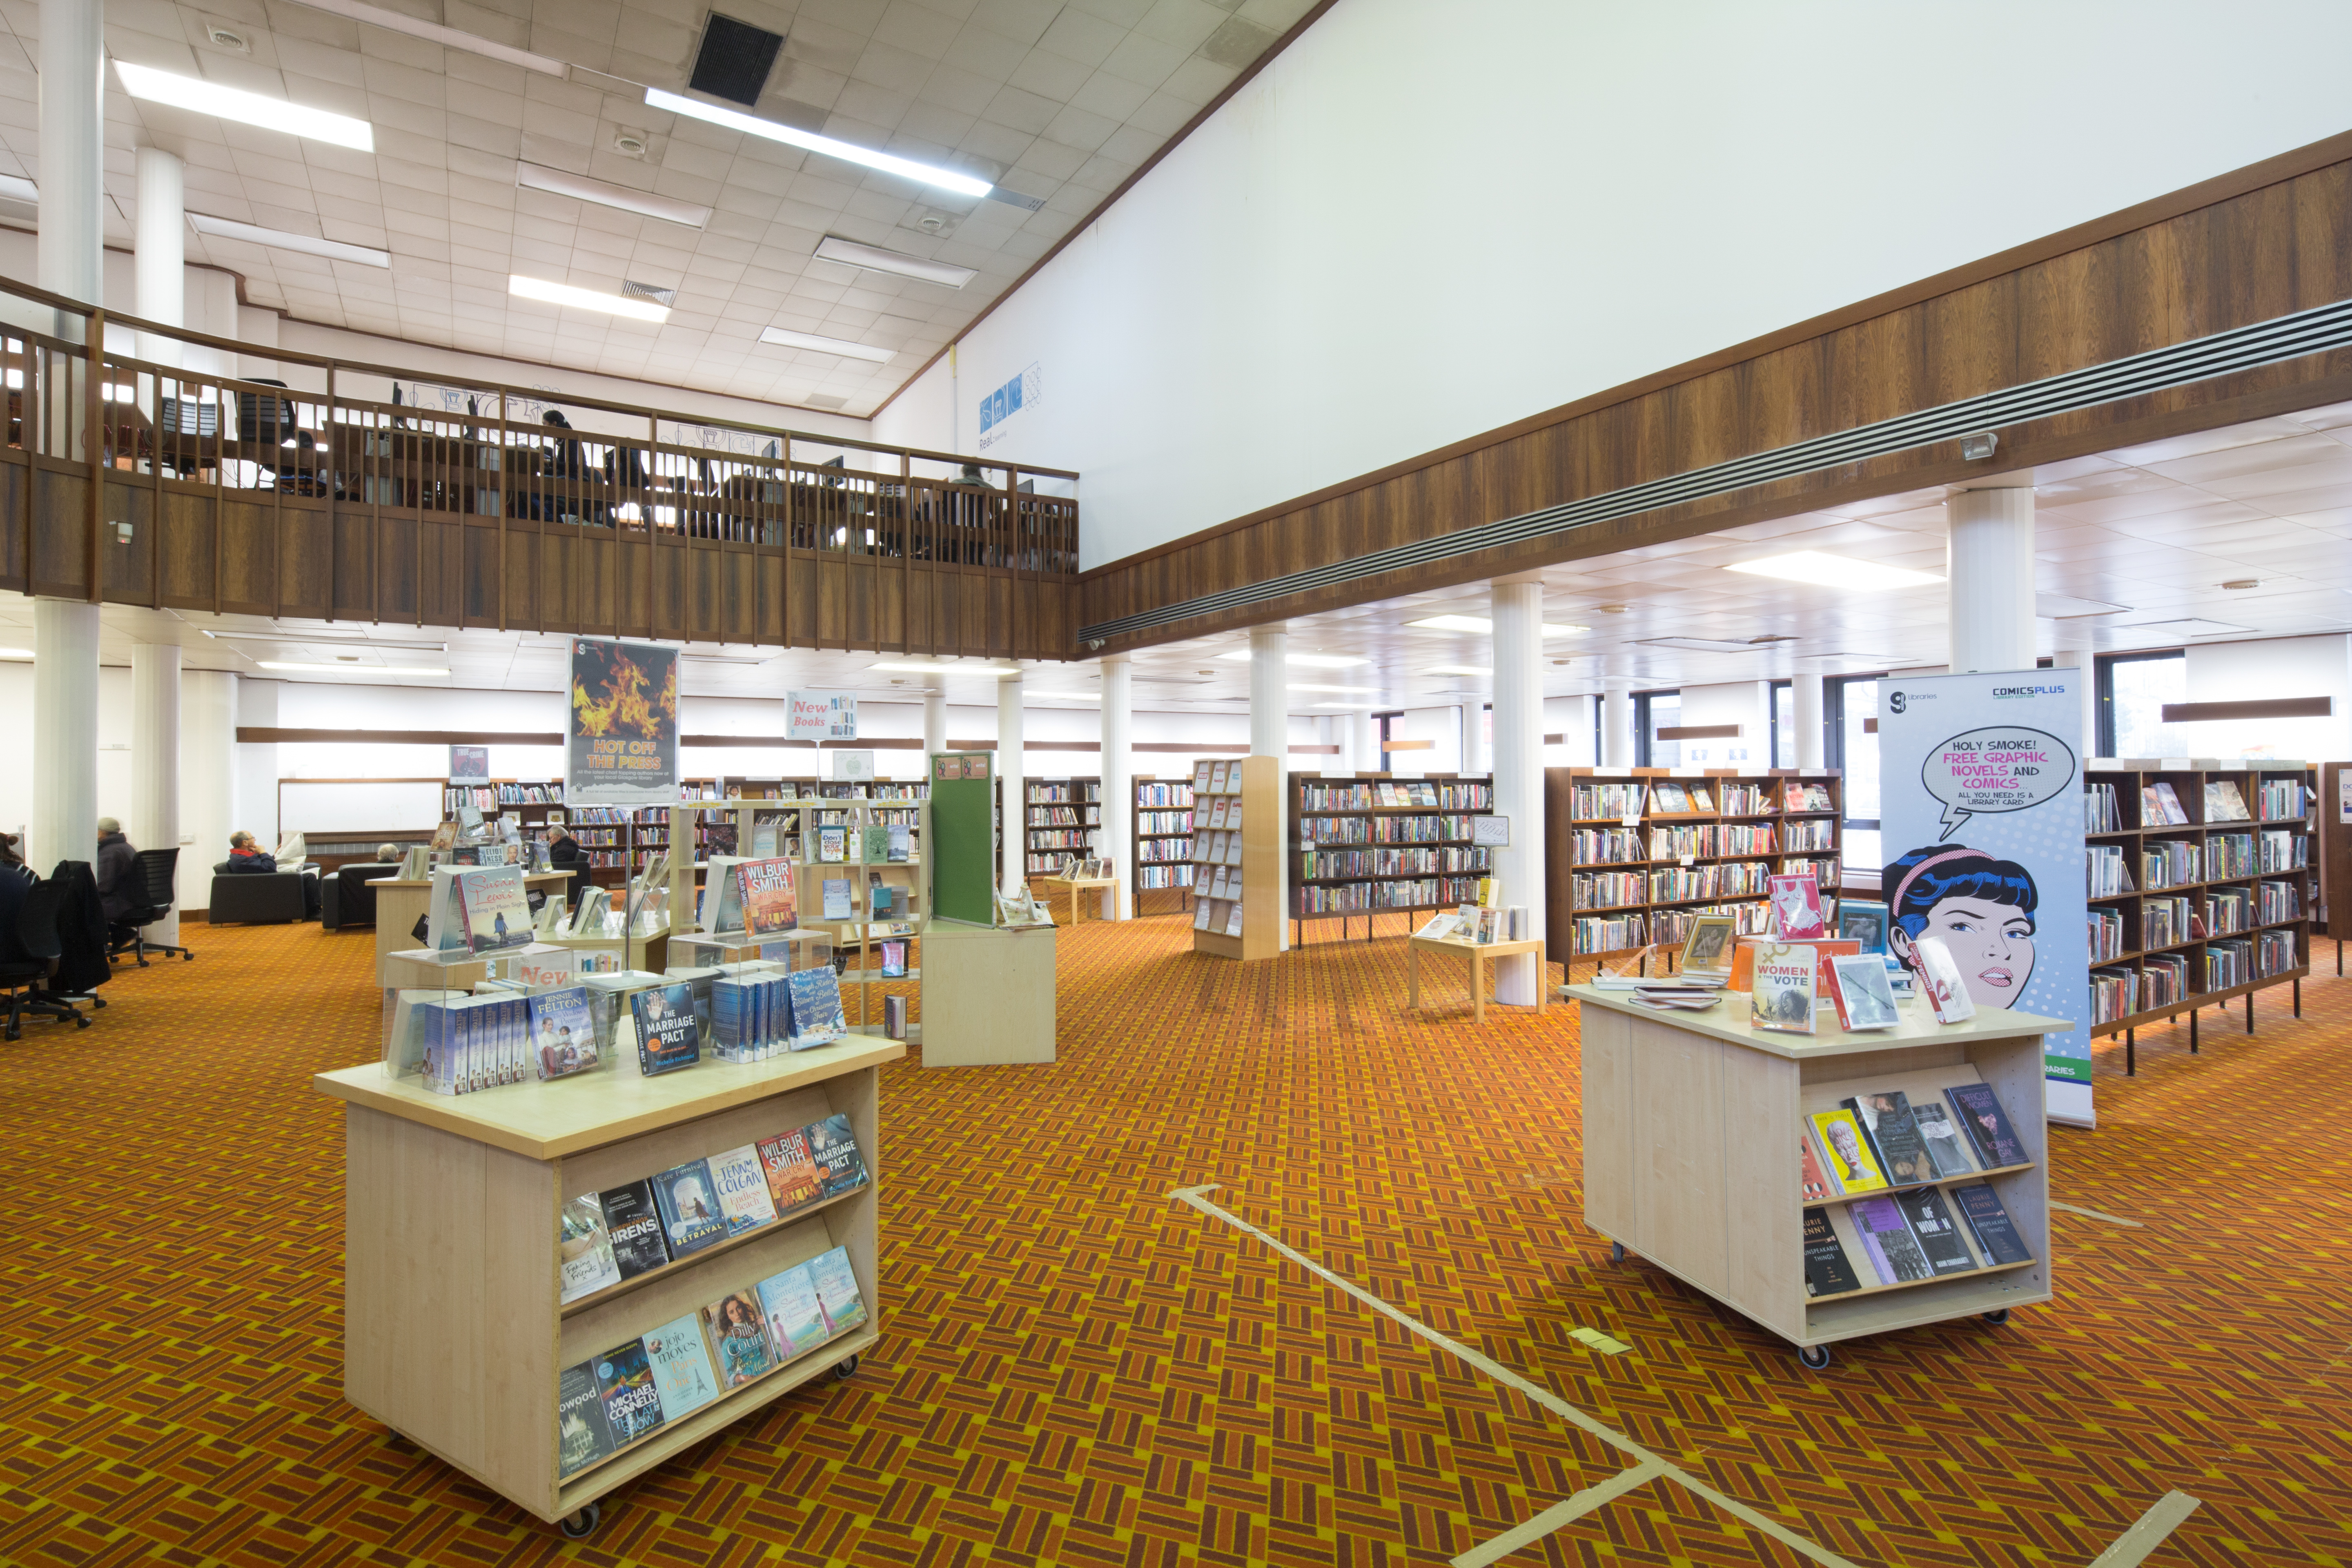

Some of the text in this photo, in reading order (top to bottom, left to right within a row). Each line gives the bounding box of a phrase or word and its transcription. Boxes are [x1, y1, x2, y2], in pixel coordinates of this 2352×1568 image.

[1993, 685, 2065, 695] COMICSPLUS
[793, 701, 828, 713] New
[793, 716, 825, 726] Books
[457, 748, 484, 759] TRUE CRIME
[594, 739, 656, 755] HOT OFF
[1953, 740, 2036, 751] HOLY SMOKE!
[587, 755, 662, 770] THE PRESS
[1943, 752, 2049, 764] FREE GRAPHIC
[1951, 765, 2040, 776] NOVELS AND
[746, 862, 789, 880] WILBUR
[468, 875, 517, 892] Susan
[737, 871, 748, 908] WILBUR SMITH
[752, 876, 788, 893] SMITH
[475, 889, 515, 906] Lewis
[527, 891, 543, 903] CRIME
[774, 891, 786, 899] CRY
[1757, 965, 1809, 976] WOMEN
[1917, 965, 1935, 992] FEMINIST
[795, 978, 834, 995] Sleigh Rides
[1774, 976, 1808, 986] VOTE
[537, 997, 582, 1014] FELTON
[545, 991, 572, 1004] JENNIE
[796, 989, 834, 1007] Silver Bells
[562, 1008, 587, 1018] Widow's
[664, 1009, 676, 1018] THE
[809, 1000, 836, 1013] Christmas
[559, 1015, 584, 1025] Promise
[647, 1015, 695, 1034] MARRIAGE
[813, 1011, 828, 1022] Fair
[661, 1029, 684, 1045] PACT
[675, 1053, 694, 1062] Richmond
[1960, 1091, 1991, 1103] DIFFICULT
[1966, 1100, 1993, 1109] WOMEN
[761, 1134, 804, 1159] WILBUR
[826, 1138, 838, 1147] THE
[1986, 1138, 2016, 1150] ROXANE
[814, 1140, 856, 1164] MARRIAGE
[1998, 1148, 2013, 1158] GAY
[769, 1148, 806, 1173] SMITH
[828, 1154, 849, 1172] PACT
[657, 1160, 706, 1183] Kate Furnivall
[719, 1158, 753, 1181] JENNY
[776, 1163, 805, 1180] WAR CRY
[718, 1169, 761, 1195] COLGAN
[730, 1189, 761, 1205] Endless
[735, 1198, 760, 1212] Beach
[1968, 1194, 1991, 1202] LAURIE
[1971, 1200, 1995, 1210] PENNY
[1922, 1206, 1934, 1219] OF
[1976, 1218, 2009, 1228] UNSPEAKABLE
[609, 1219, 657, 1245] SIRENS
[676, 1223, 723, 1246] BETRAYAL
[1804, 1245, 1839, 1256] UNSPEAKABLE
[1814, 1254, 1835, 1262] THINGS
[566, 1260, 590, 1274] Faking
[811, 1261, 848, 1282] Montefiore
[816, 1258, 835, 1270] Santa
[571, 1265, 597, 1281] Friends
[767, 1279, 809, 1303] Montefiore
[775, 1276, 796, 1290] Santa
[823, 1282, 856, 1300] Hummingbird
[782, 1301, 817, 1321] Hummingbird
[731, 1321, 757, 1340] Dilly
[665, 1332, 684, 1350] jojo
[726, 1331, 764, 1356] Court
[658, 1339, 697, 1365] moyes
[671, 1357, 697, 1374] Paris
[732, 1356, 754, 1374] River
[753, 1355, 771, 1375] Maid
[666, 1376, 690, 1391] One
[609, 1383, 655, 1410] MICHAEL
[677, 1392, 692, 1401] STORIES
[609, 1390, 658, 1421] CONNELLY
[636, 1401, 661, 1420] LATE
[623, 1412, 655, 1437] SHOW
[567, 1453, 599, 1472] Laura McHugh
